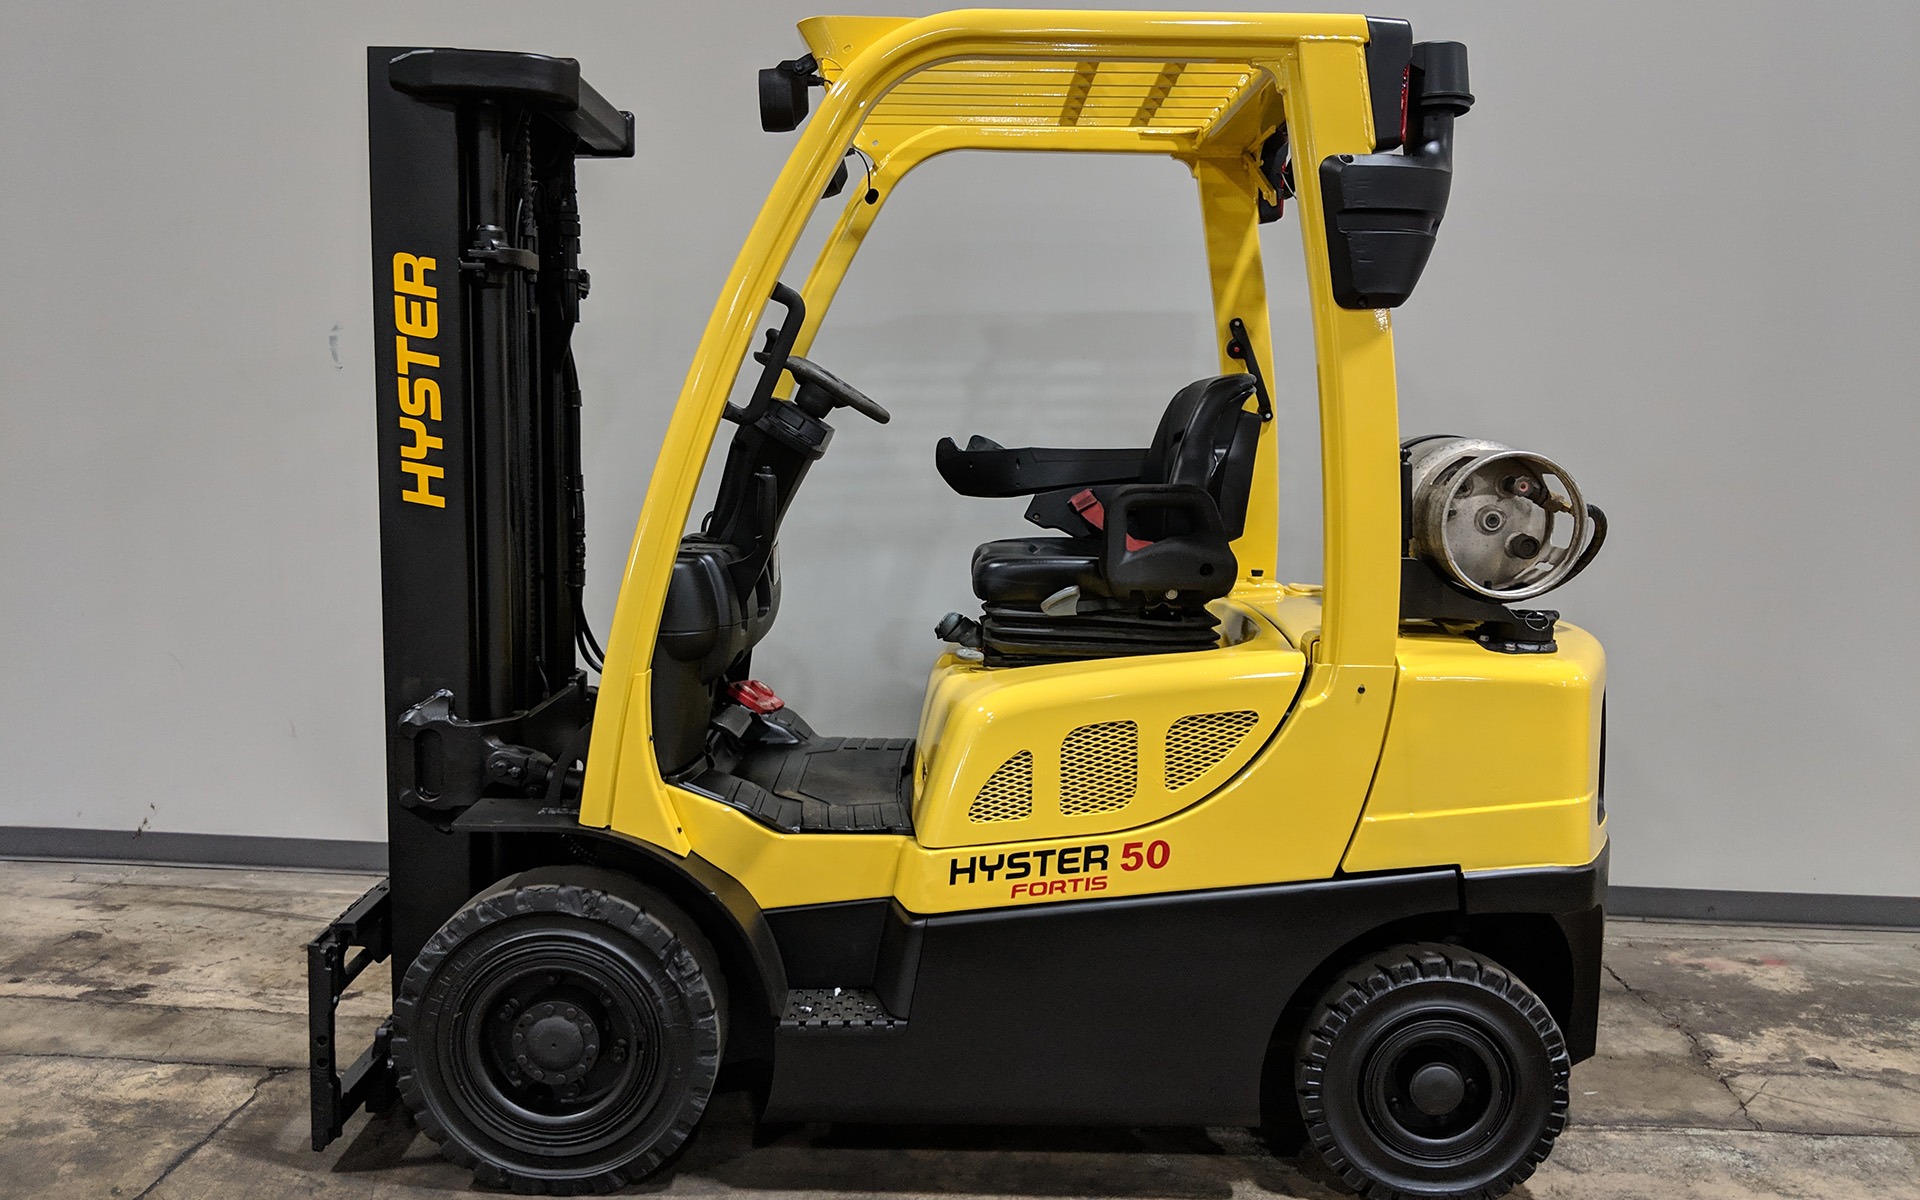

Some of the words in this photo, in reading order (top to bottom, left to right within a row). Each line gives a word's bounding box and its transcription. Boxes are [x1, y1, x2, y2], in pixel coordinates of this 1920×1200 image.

[393, 252, 445, 508] HYSTER
[949, 844, 1109, 886] HYSTER
[1120, 840, 1171, 871] 50
[1011, 876, 1108, 898] FORTIS
